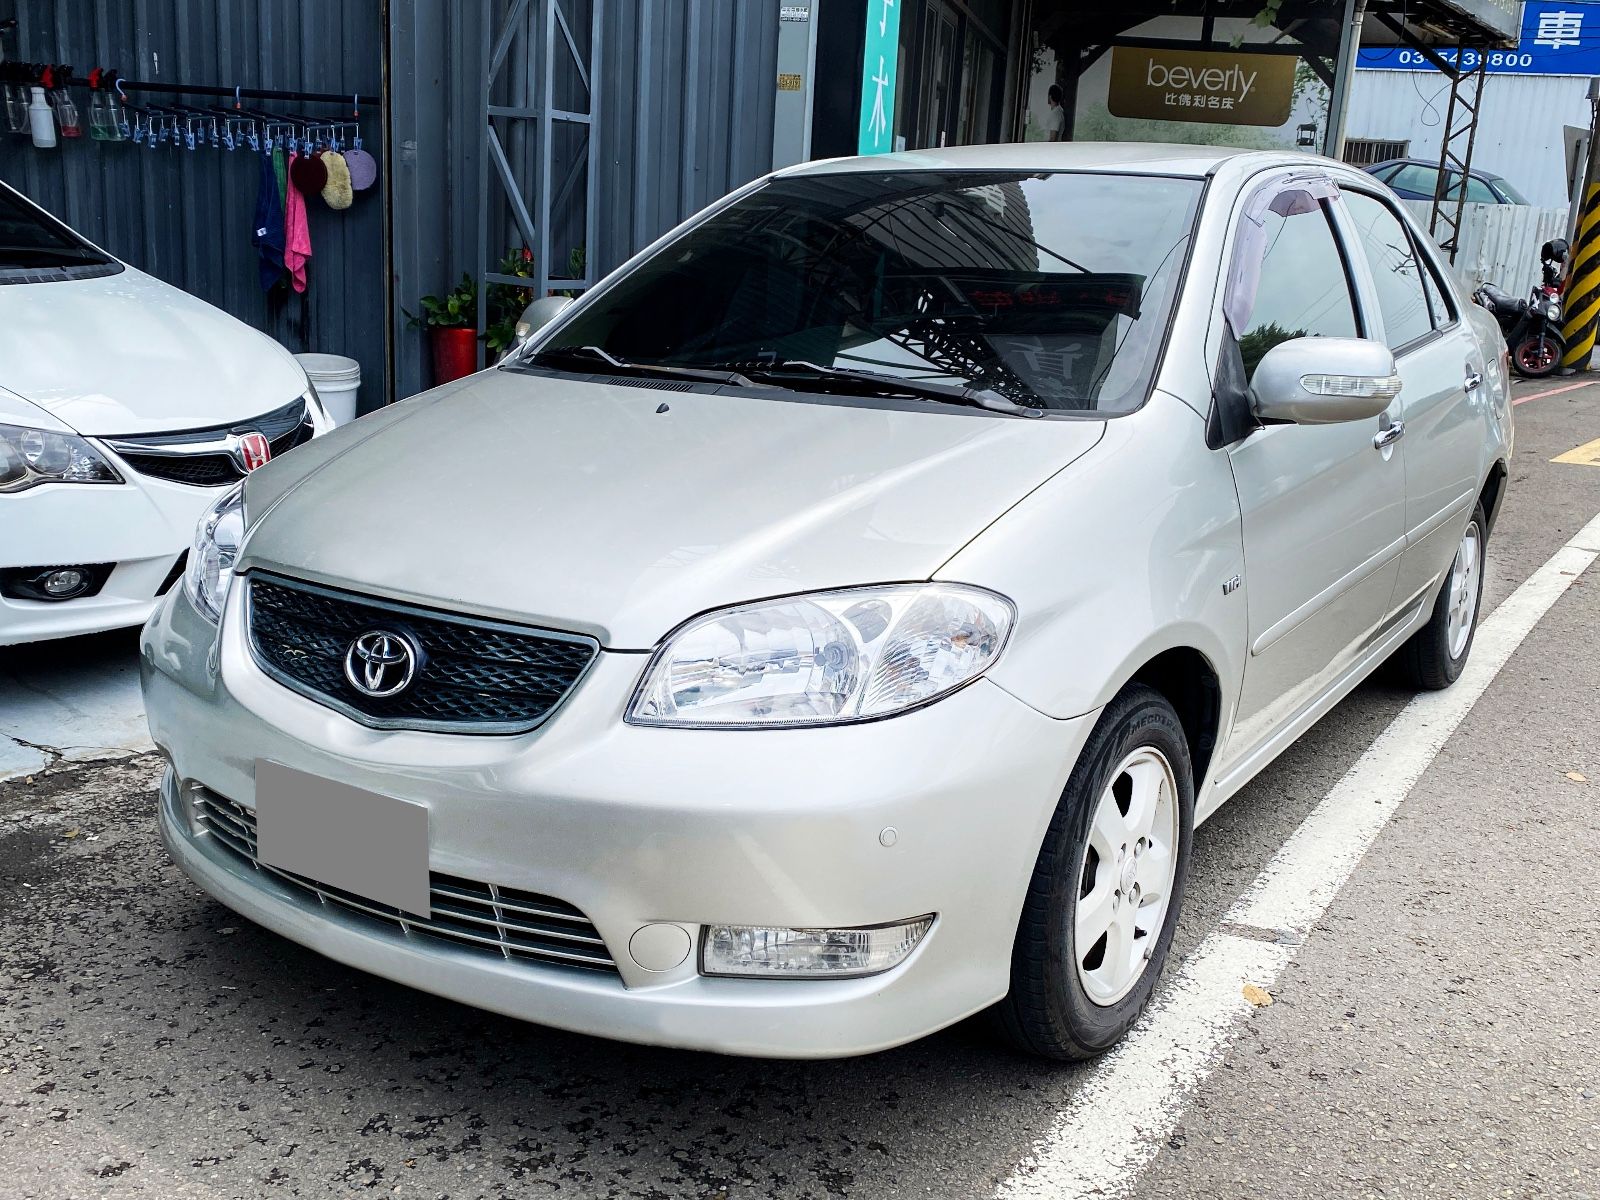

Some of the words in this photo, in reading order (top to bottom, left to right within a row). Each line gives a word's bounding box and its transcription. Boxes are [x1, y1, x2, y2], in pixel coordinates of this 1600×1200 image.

[1533, 10, 1585, 49] 車
[1147, 57, 1258, 103] beverly
[1164, 91, 1235, 110] 比佛利名床
